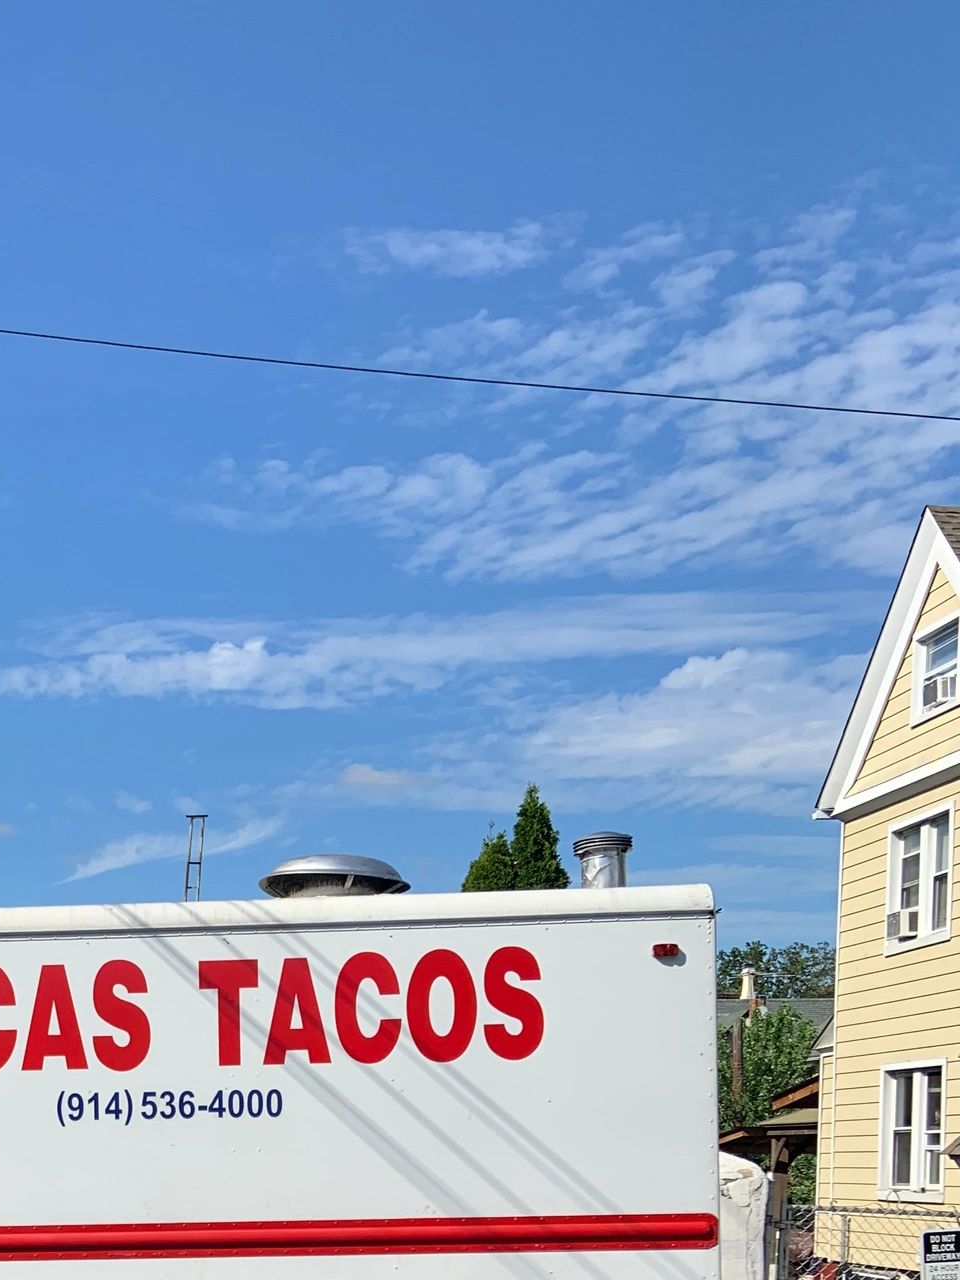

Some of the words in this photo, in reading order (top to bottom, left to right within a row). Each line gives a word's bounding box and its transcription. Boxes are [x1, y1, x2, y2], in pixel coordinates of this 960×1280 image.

[199, 946, 544, 1066] TACOS
[57, 1090, 132, 1126] (914)
[141, 1089, 282, 1120] 536-4000
[930, 1235, 940, 1243] DO
[941, 1234, 956, 1242] NOT
[932, 1243, 955, 1252] BLOCK
[932, 1273, 958, 1280] ACCESS
